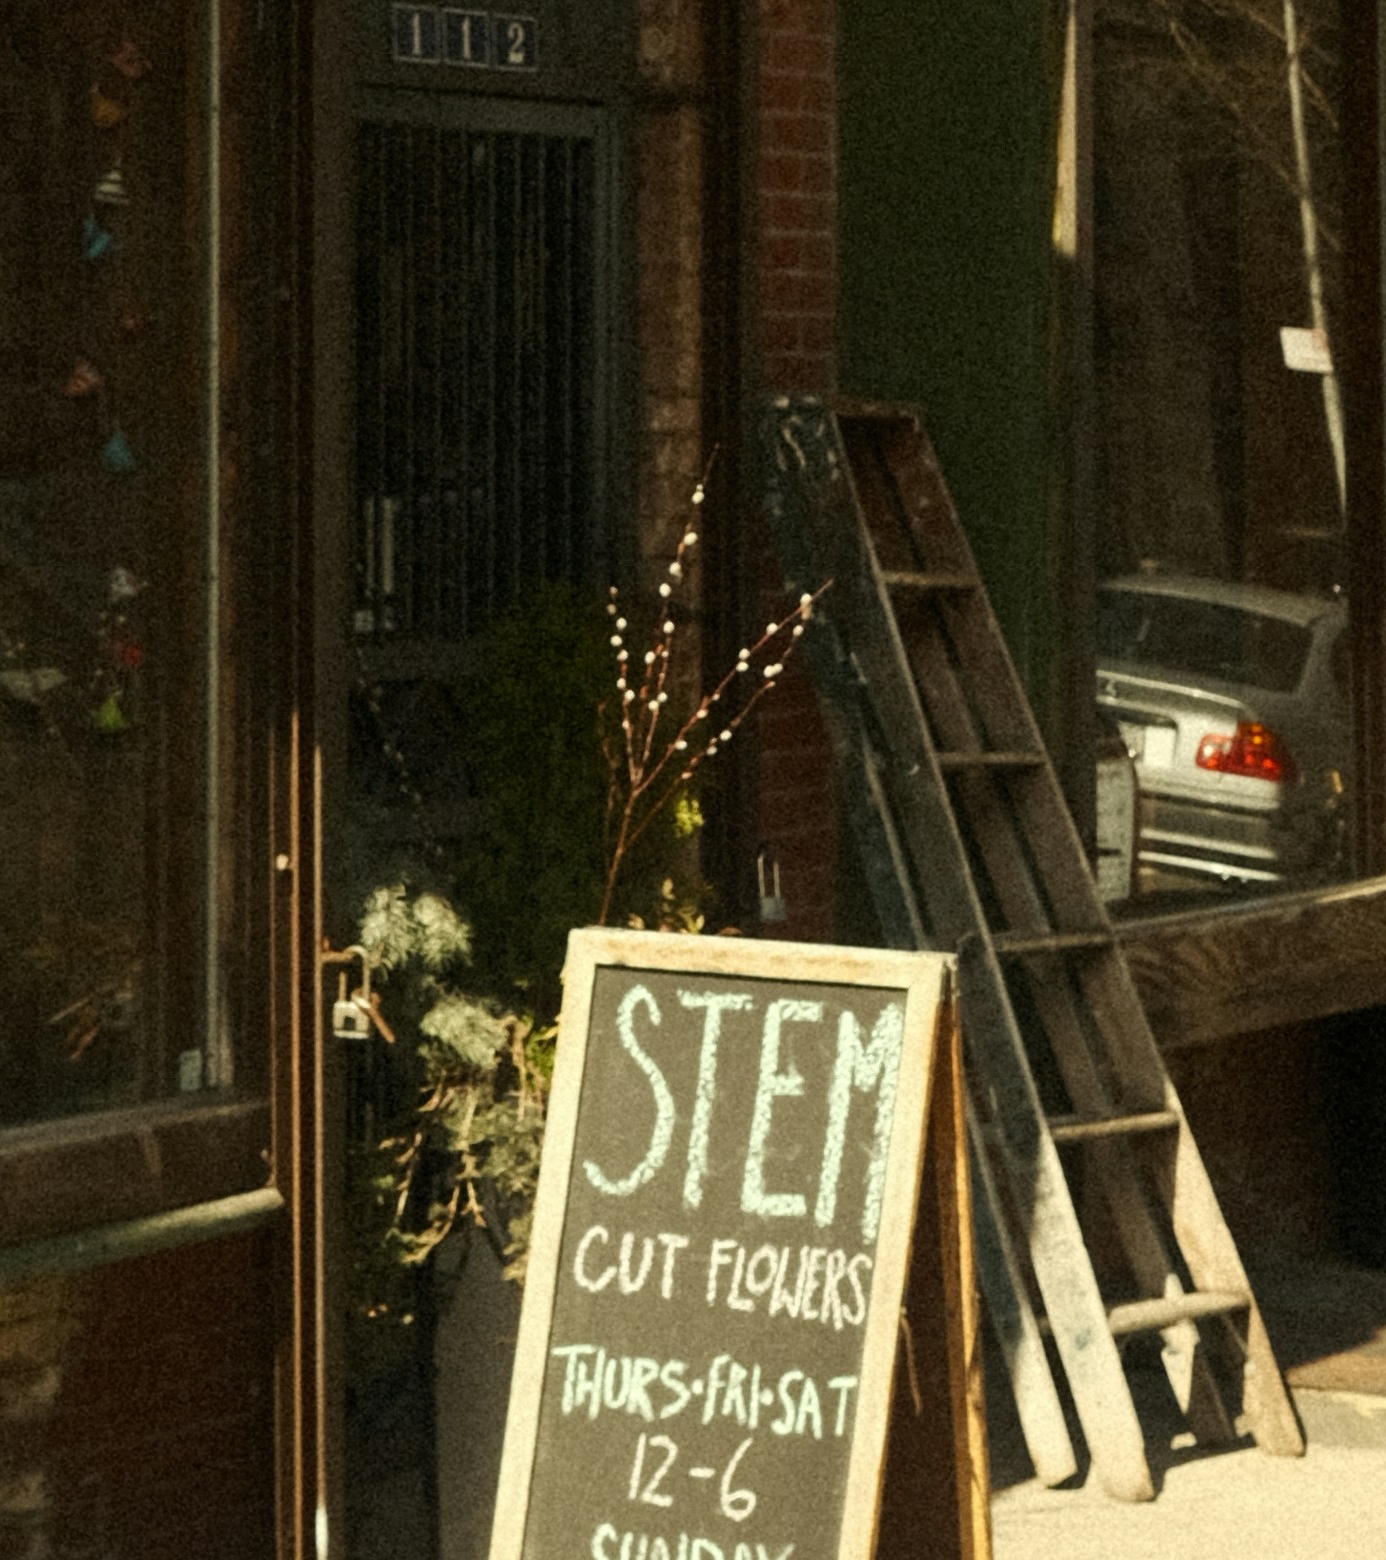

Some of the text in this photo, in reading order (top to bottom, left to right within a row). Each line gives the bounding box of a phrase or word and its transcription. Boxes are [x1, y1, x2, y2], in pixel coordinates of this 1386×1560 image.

[410, 12, 526, 64] 112
[582, 983, 905, 1245] STEM
[573, 1225, 874, 1331] CUT FLOWERS
[627, 1432, 758, 1522] 12-6
